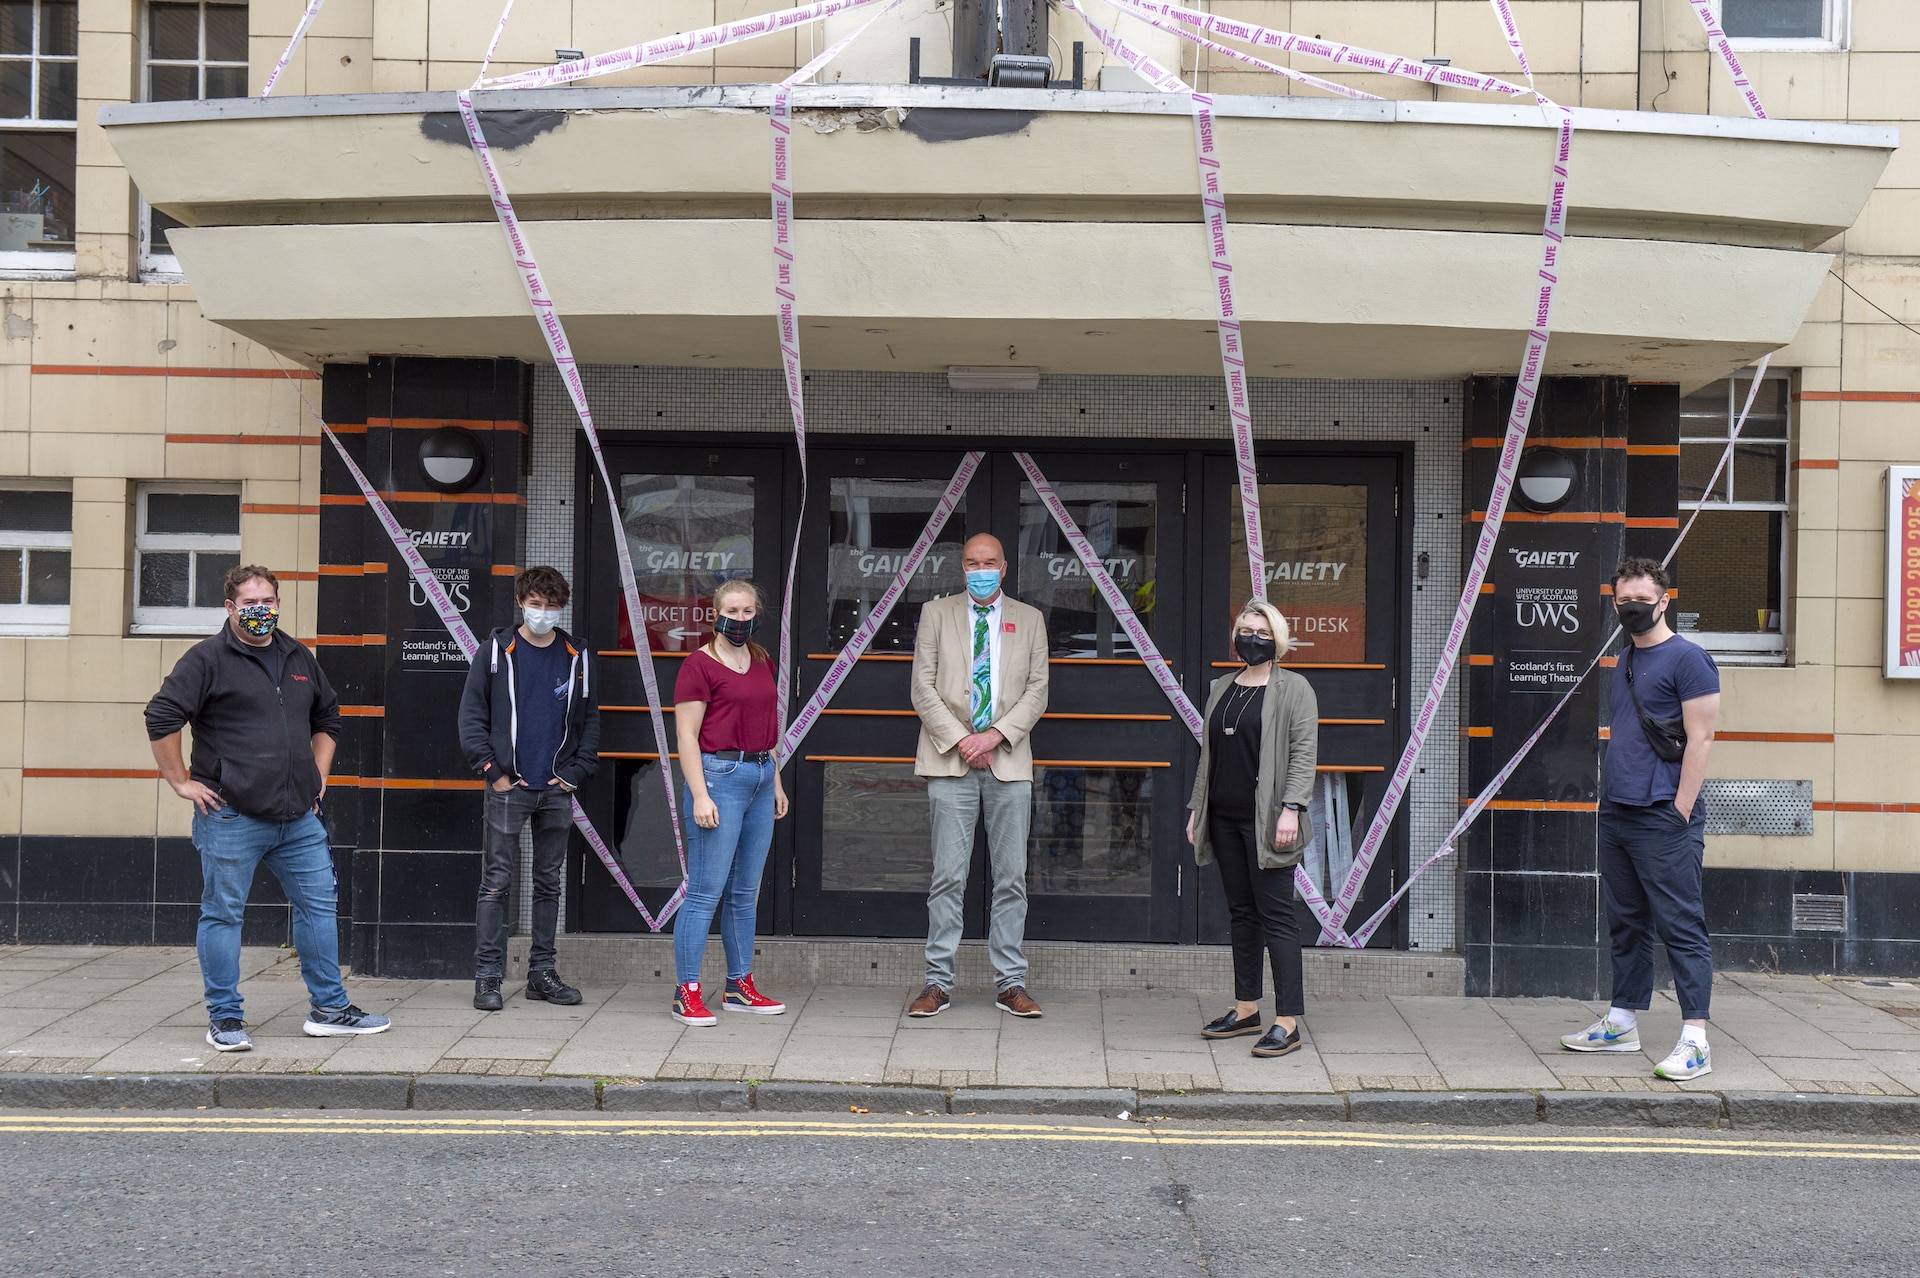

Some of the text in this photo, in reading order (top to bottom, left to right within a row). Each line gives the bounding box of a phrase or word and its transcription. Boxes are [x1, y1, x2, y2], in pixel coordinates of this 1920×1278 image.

[779, 10, 811, 26] THEATRE
[1171, 11, 1202, 26] MISSING
[1700, 7, 1715, 26] LIVE
[732, 22, 765, 37] MISSING
[1216, 22, 1249, 39] THEATRE
[648, 39, 684, 55] THEATRE
[701, 34, 717, 44] LIVE
[1264, 34, 1282, 46] LIVE
[1297, 40, 1332, 57] MISSING
[596, 51, 632, 67] MISSING
[1348, 52, 1385, 73] THEATRE
[1718, 40, 1742, 76] MISSING
[560, 62, 578, 74] LIVE
[1120, 44, 1138, 64] THEATRE
[1142, 61, 1162, 80] MISSING
[1165, 78, 1179, 91] LIVE
[1404, 64, 1422, 76] LIVE
[1440, 71, 1479, 87] MISSING
[776, 94, 786, 116] LIVE
[775, 137, 786, 180] MISSING
[777, 201, 788, 243] THEATRE
[780, 264, 790, 284] LIVE
[504, 215, 526, 256] MISSING
[526, 274, 542, 295] LIVE
[542, 311, 566, 354] THEATRE
[566, 368, 586, 407] MISSING
[781, 304, 793, 343] MISSING
[1199, 110, 1262, 596] MISSING LIVE THEATRE MISSING LIVE THEATRE MISSING LIVE THEATRE MISSING
[787, 360, 797, 396] THEATRE
[344, 454, 368, 488] THEATRE
[375, 500, 400, 534] MISSING
[405, 546, 420, 565] LIVE
[425, 577, 451, 613] THEATRE
[409, 531, 472, 548] GAIETY
[647, 552, 734, 574] GAIETY
[1329, 912, 1343, 929] LIVE
[1342, 866, 1363, 900] THEATRE
[1363, 822, 1383, 856] MISSING
[1384, 792, 1396, 811] LIVE
[1397, 744, 1416, 780] THEATRE
[1417, 698, 1435, 734] MISSING
[1436, 667, 1447, 686] LIVE
[1447, 617, 1464, 654] THEATRE
[1464, 569, 1480, 605] MISSING
[1479, 536, 1491, 556] LIVE
[1488, 484, 1505, 522] THEATRE
[1502, 434, 1519, 470] MISSING
[1515, 400, 1528, 418] LIVE
[1523, 345, 1541, 382] THEATRE
[1536, 286, 1551, 327] MISSING
[1544, 246, 1556, 266] LIVE
[1550, 182, 1564, 225] THEATRE
[1516, 551, 1580, 568] GAIETY
[790, 461, 974, 738] THEATRE MISSING LIVE THEATRE MISSING LIVE THEATRE
[641, 607, 714, 622] ICKET DE
[1048, 496, 1073, 528] MISSING
[1077, 540, 1093, 559] LIVE
[1097, 571, 1122, 607] THEATRE
[1126, 617, 1151, 652] MISSING
[1154, 663, 1170, 682] LIVE
[1174, 694, 1200, 729] THEATRE
[1516, 603, 1579, 633] UWS
[1305, 617, 1349, 633] DESK
[402, 641, 446, 650] Scotland's
[402, 652, 439, 663] Learning
[1510, 662, 1574, 671] Scotland's first
[1510, 673, 1582, 684] Learning Theatre
[585, 824, 610, 860] THEATRE
[615, 870, 639, 904] MISSING
[1318, 906, 1329, 921] LIV
